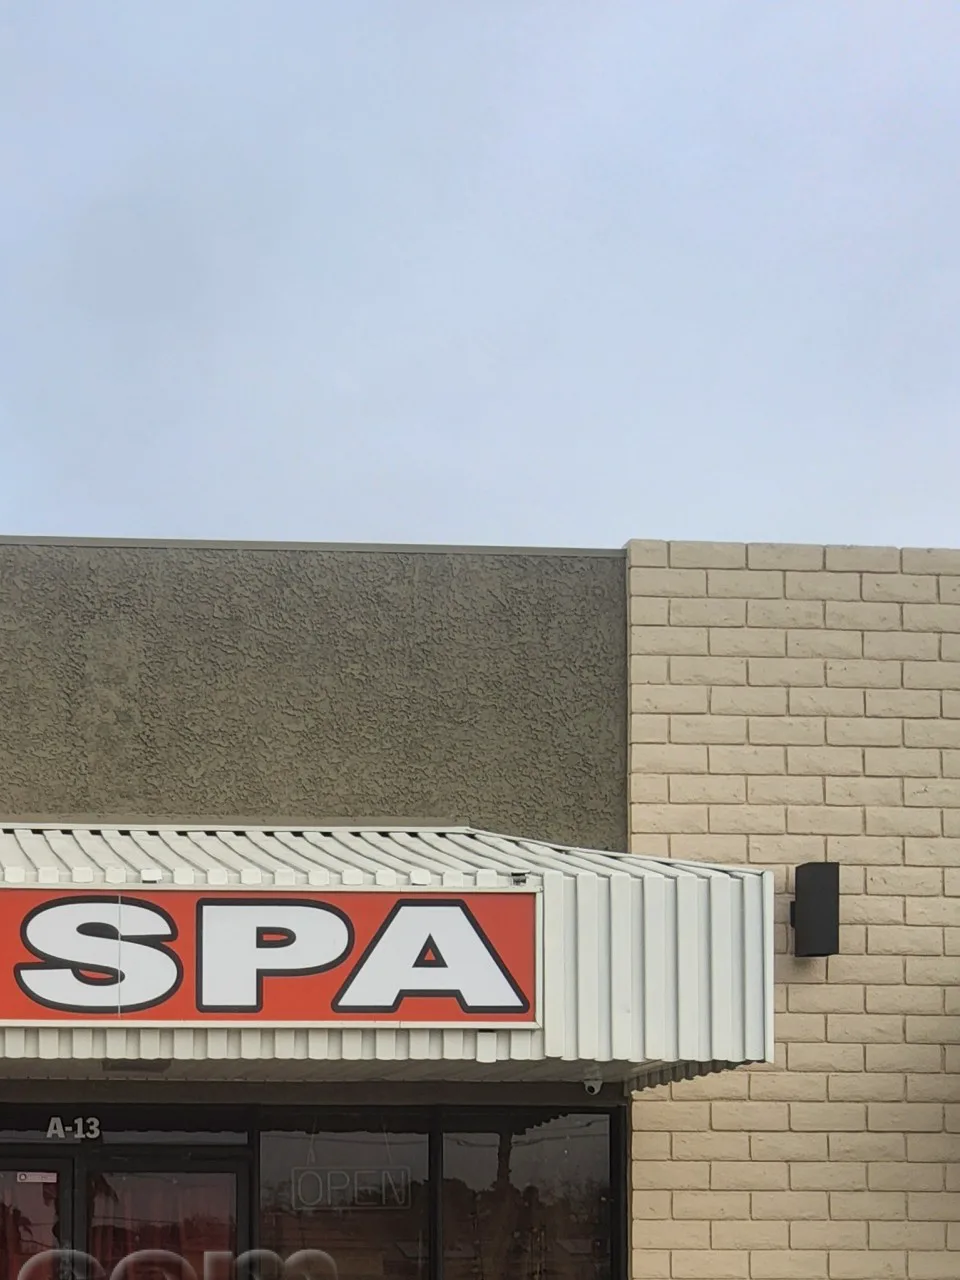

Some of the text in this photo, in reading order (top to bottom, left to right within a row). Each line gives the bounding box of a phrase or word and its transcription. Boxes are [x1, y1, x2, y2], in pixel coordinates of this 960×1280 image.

[15, 893, 531, 1014] SPA
[46, 1116, 101, 1139] A-13
[297, 1169, 406, 1206] OPEN
